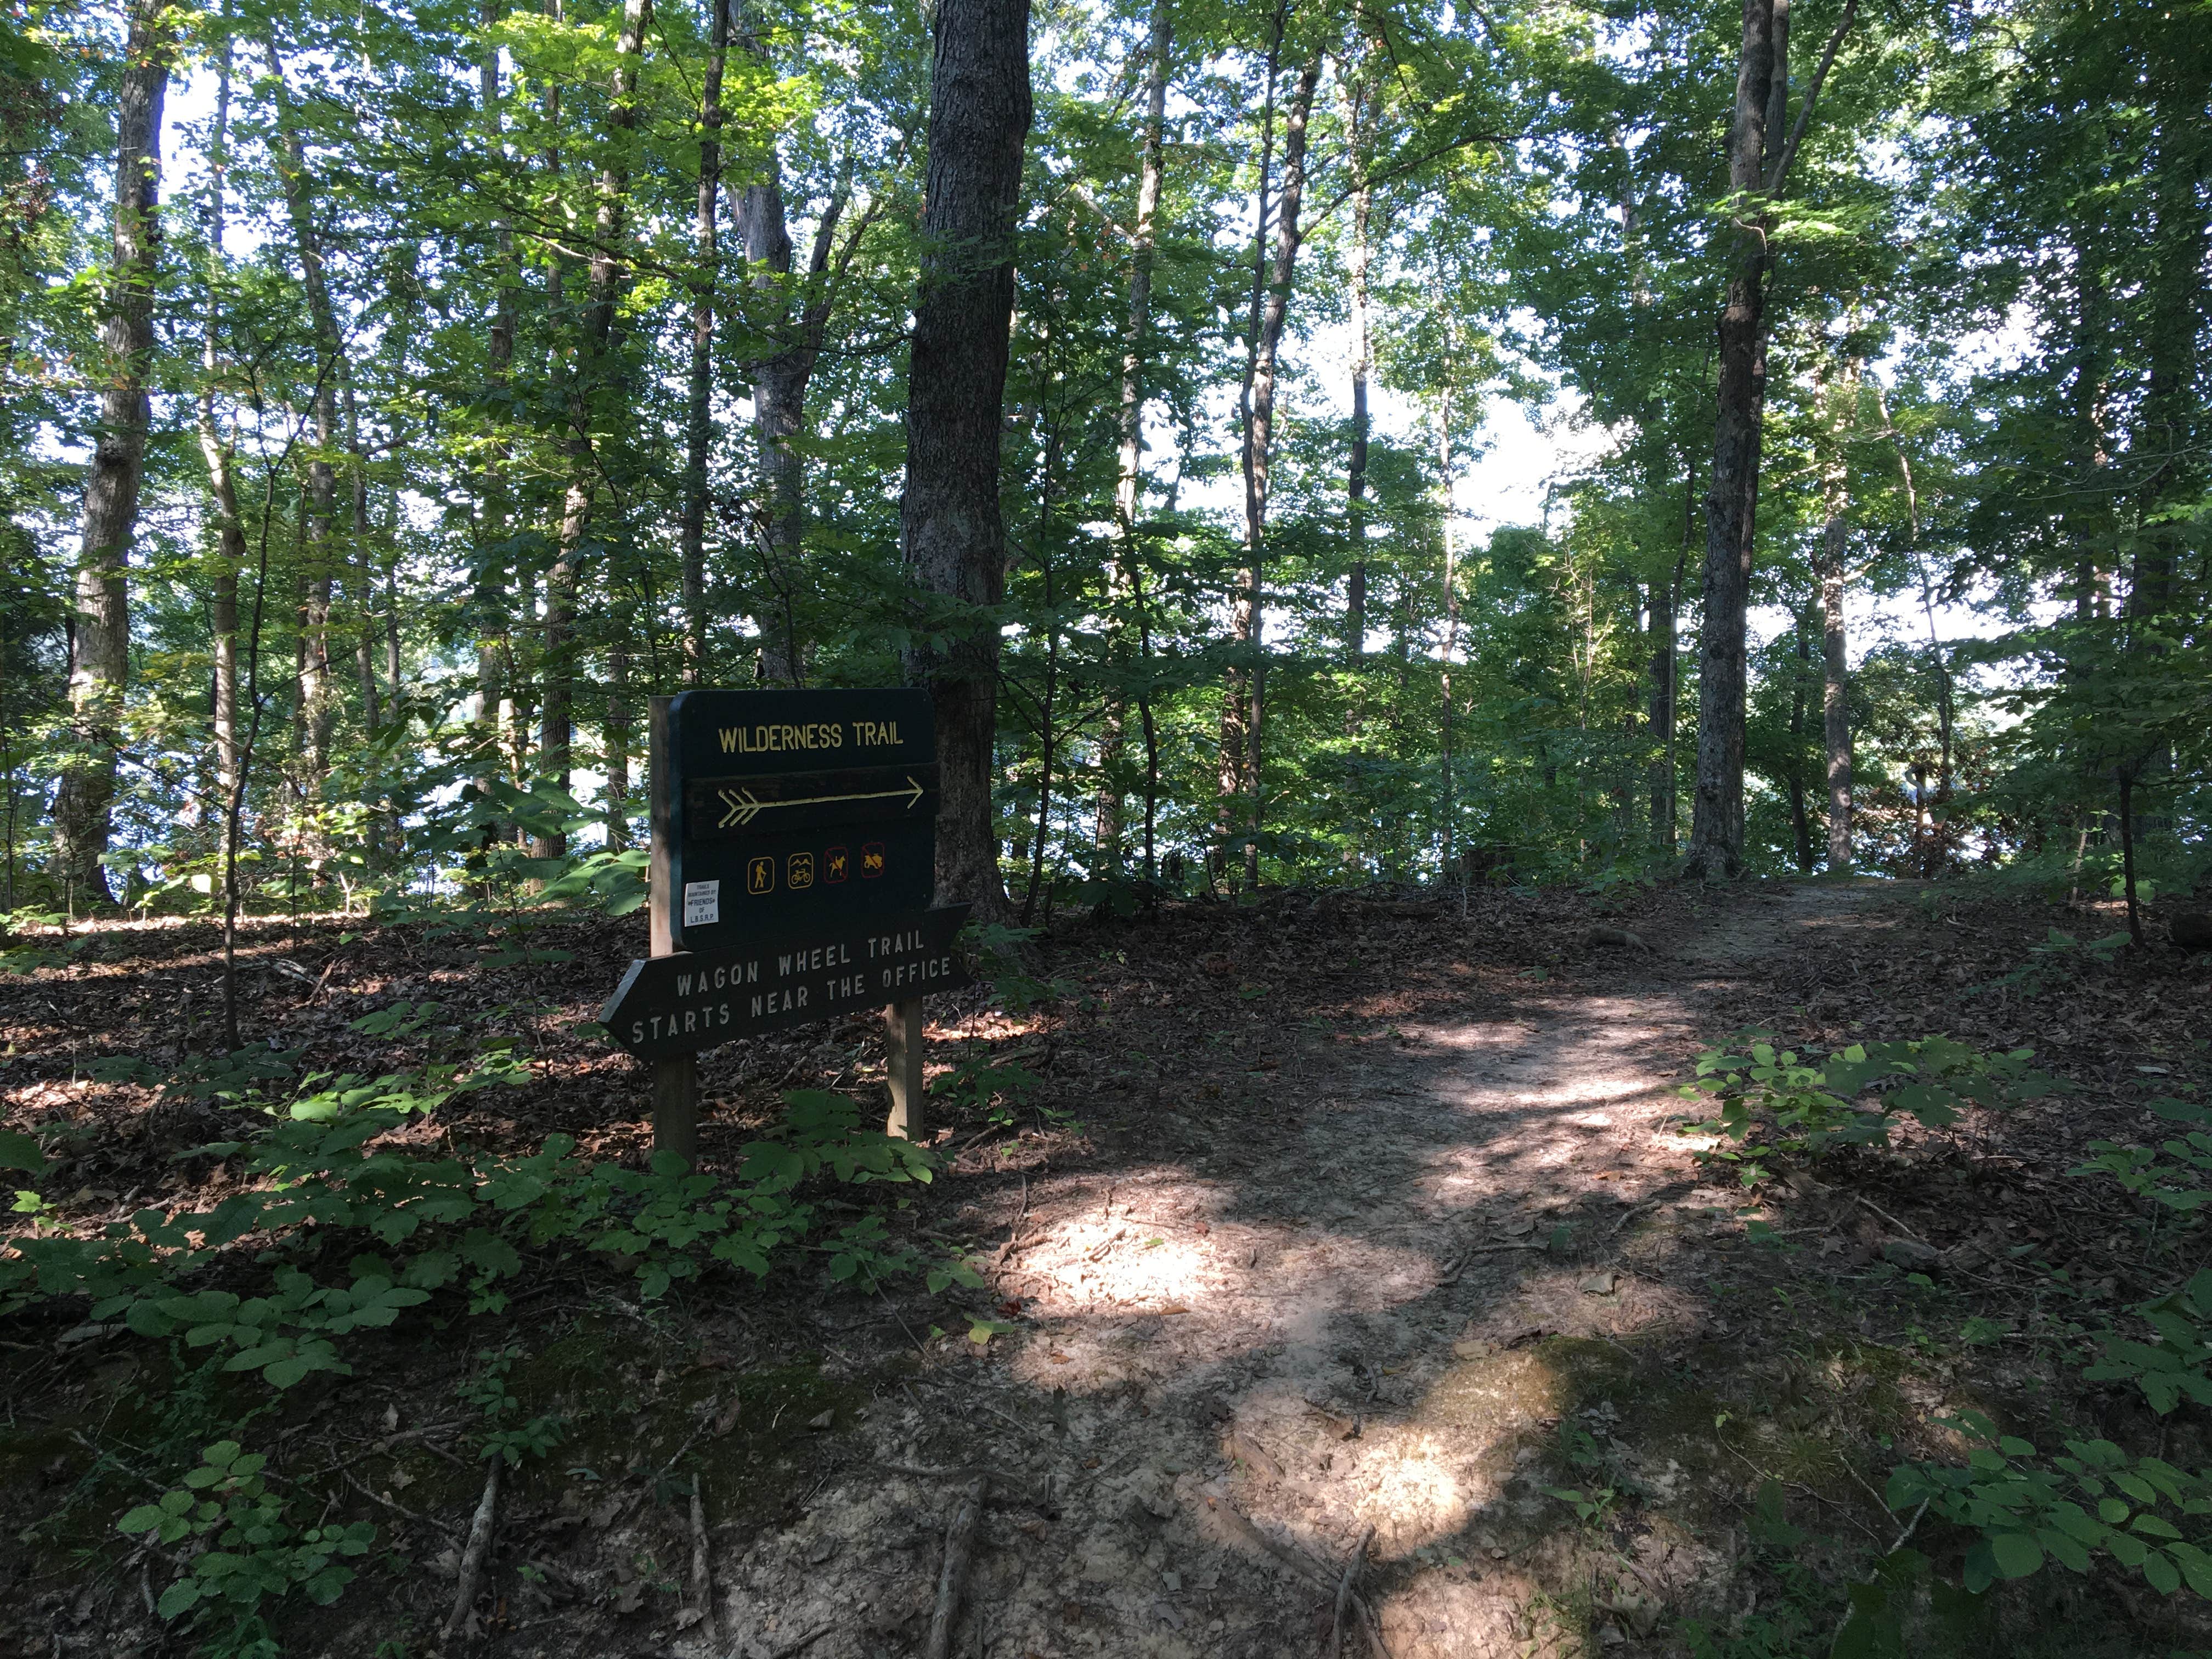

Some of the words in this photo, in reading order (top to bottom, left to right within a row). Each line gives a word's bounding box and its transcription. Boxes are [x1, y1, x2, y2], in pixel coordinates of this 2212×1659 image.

[718, 723, 842, 753] WILDERNESS
[852, 720, 904, 746] TRAIL
[691, 898, 713, 906] FRIENDS
[677, 961, 758, 997] WAGON
[778, 943, 850, 977] WHEEL
[868, 930, 924, 958] TRAIL
[632, 1003, 730, 1043] STARTS
[752, 985, 808, 1018] NEAR
[827, 973, 865, 1000] THE
[882, 957, 950, 988] OFFICE
